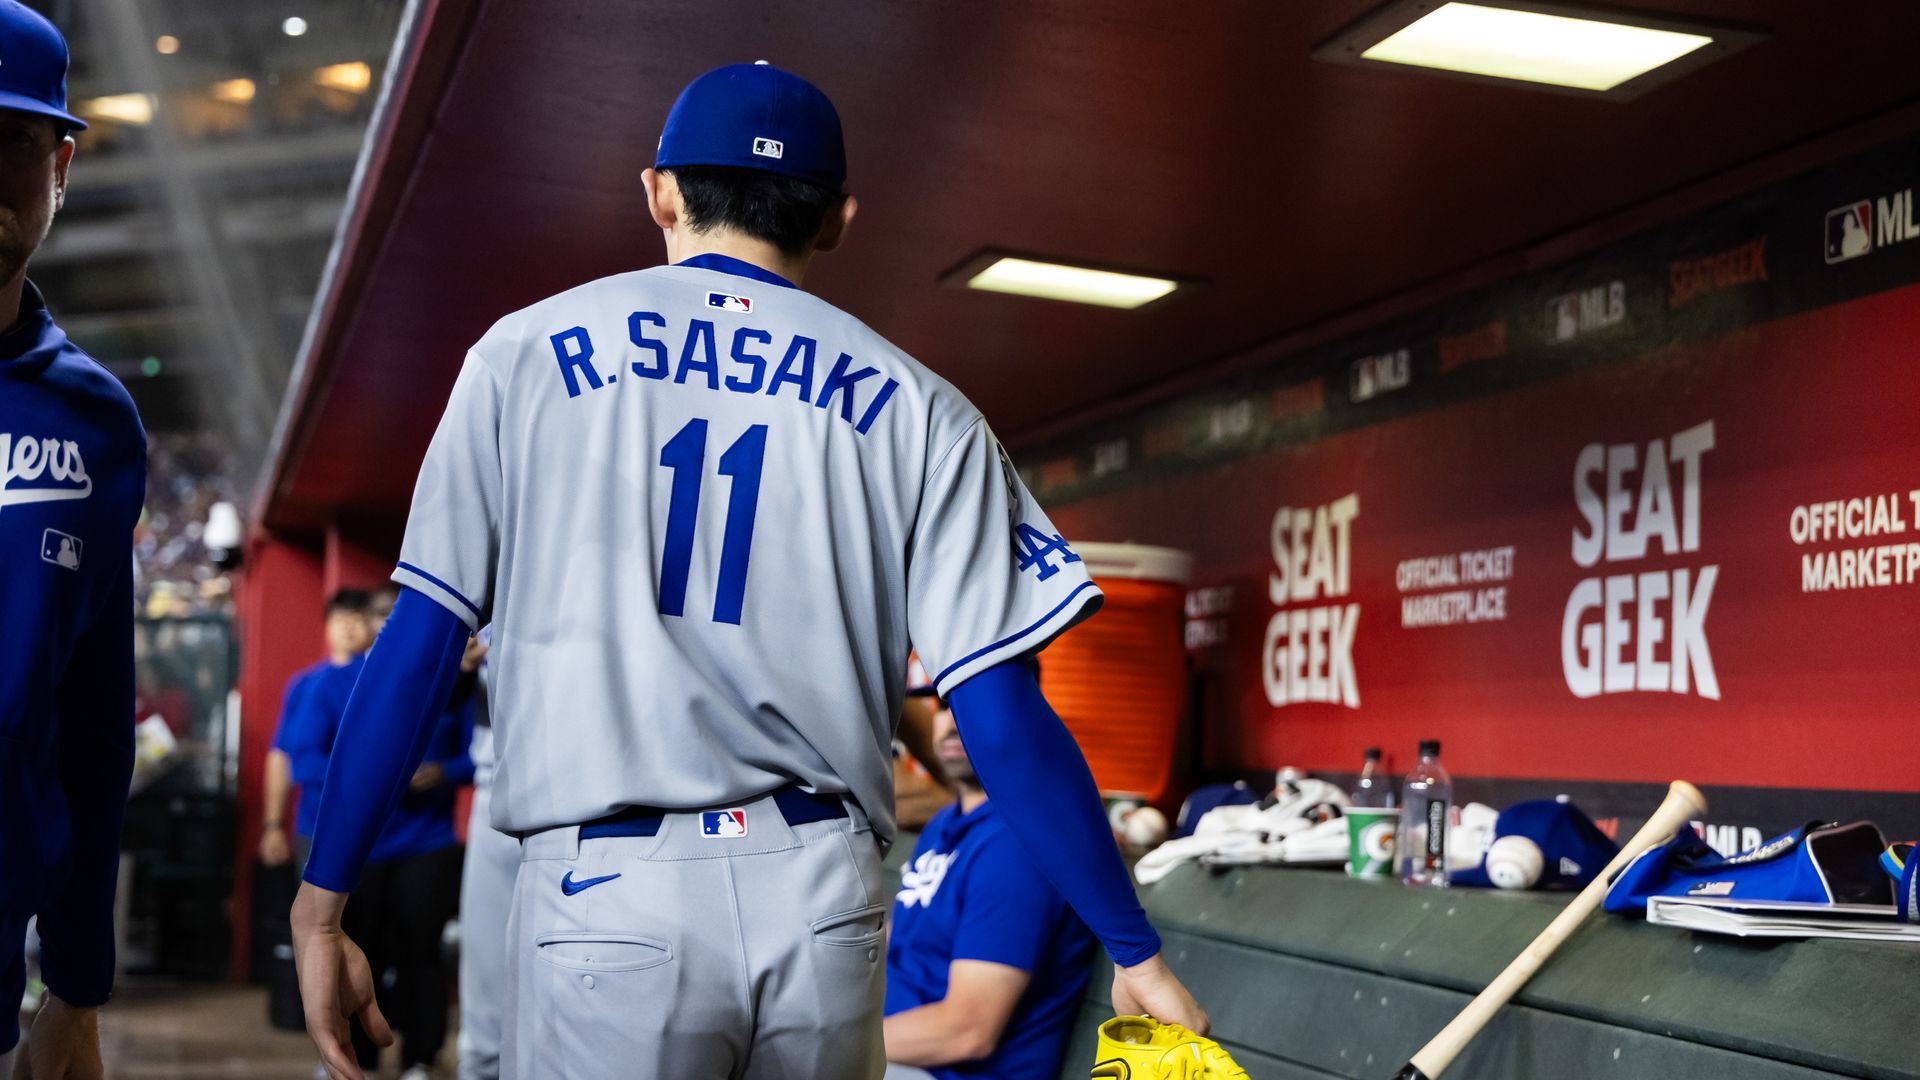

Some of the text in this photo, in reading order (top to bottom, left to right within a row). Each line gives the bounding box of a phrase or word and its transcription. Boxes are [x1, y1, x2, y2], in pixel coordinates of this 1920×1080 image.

[658, 417, 768, 626] 11
[1571, 419, 1715, 568] SEAT
[1790, 493, 1905, 544] OFFICIAL
[1269, 493, 1360, 606] SEAT
[1396, 546, 1515, 592] OFFICIAL TICKET
[1262, 603, 1361, 709] GEEK
[1402, 587, 1507, 629] MARKETPLACE
[1561, 564, 1721, 700] GEEK
